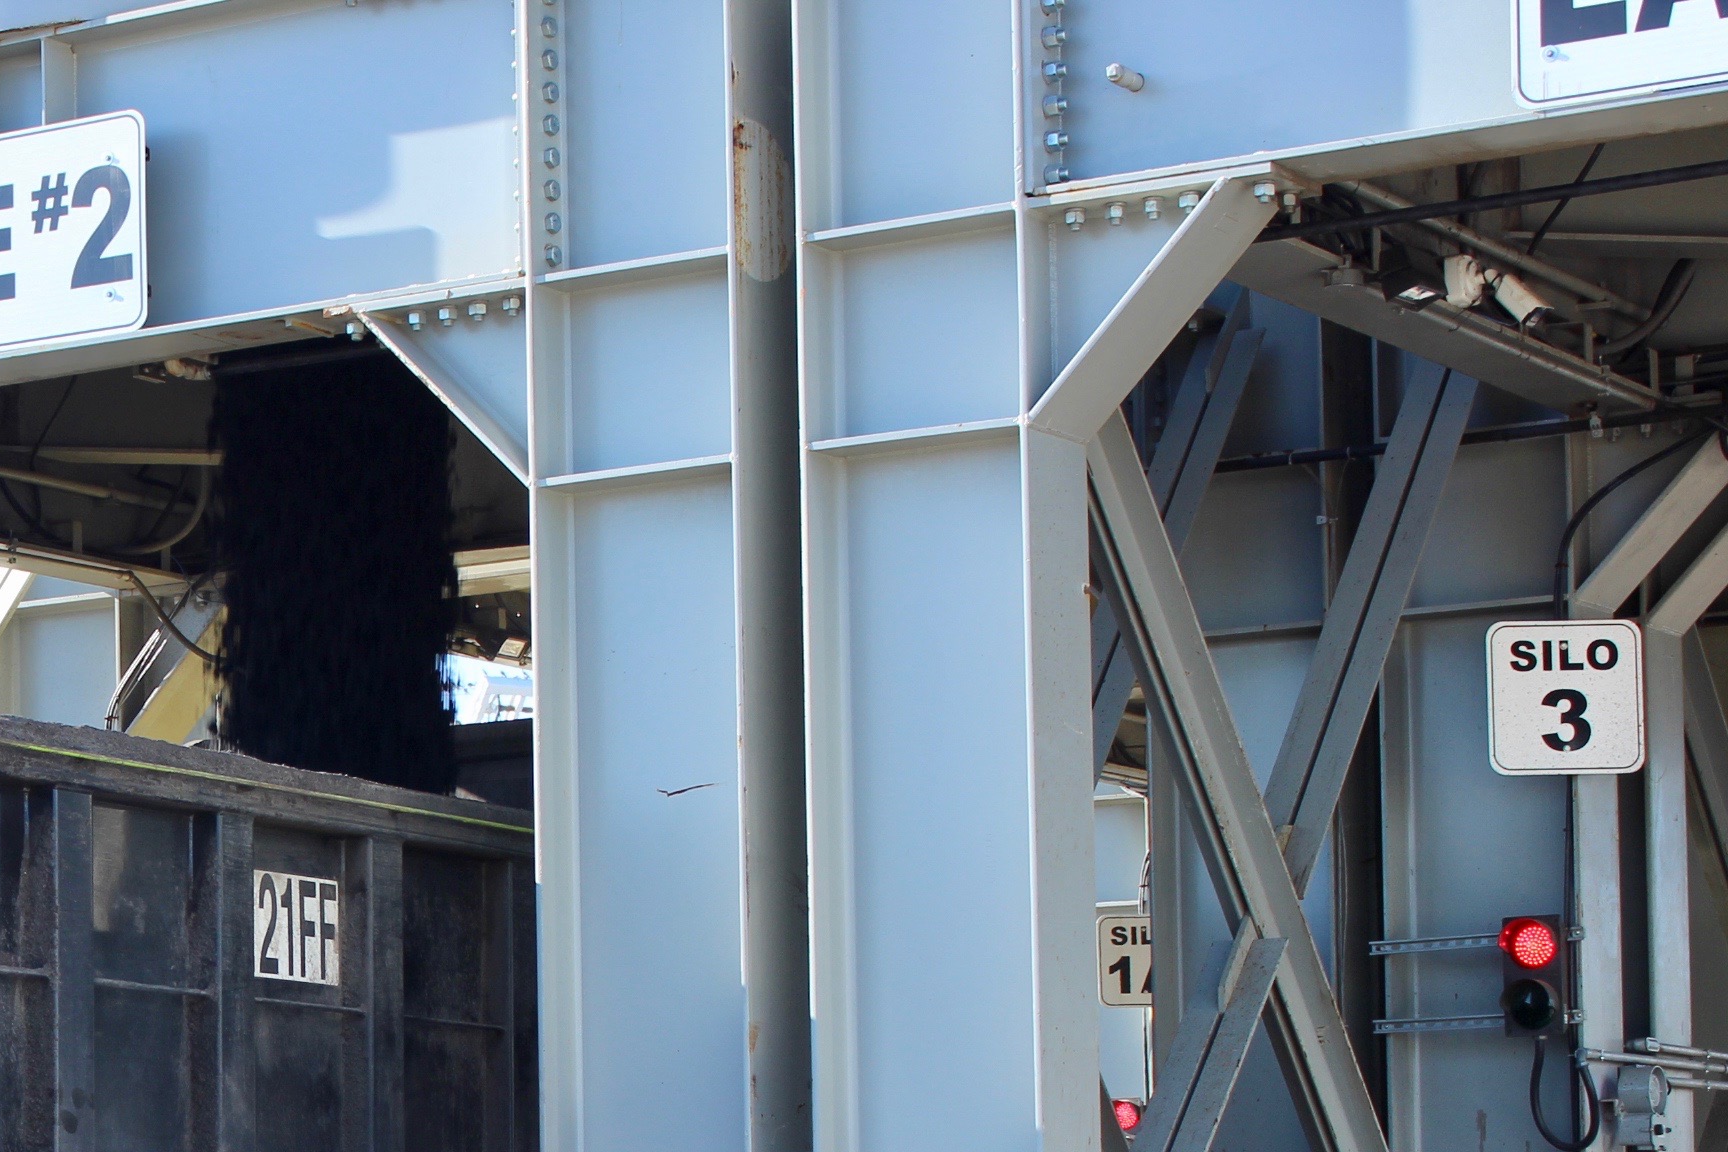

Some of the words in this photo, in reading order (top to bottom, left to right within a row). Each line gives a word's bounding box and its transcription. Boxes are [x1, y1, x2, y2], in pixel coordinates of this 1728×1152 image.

[31, 164, 134, 290] #2
[1510, 639, 1619, 672] SILO
[1541, 688, 1592, 752] 3
[258, 872, 337, 981] 21FF
